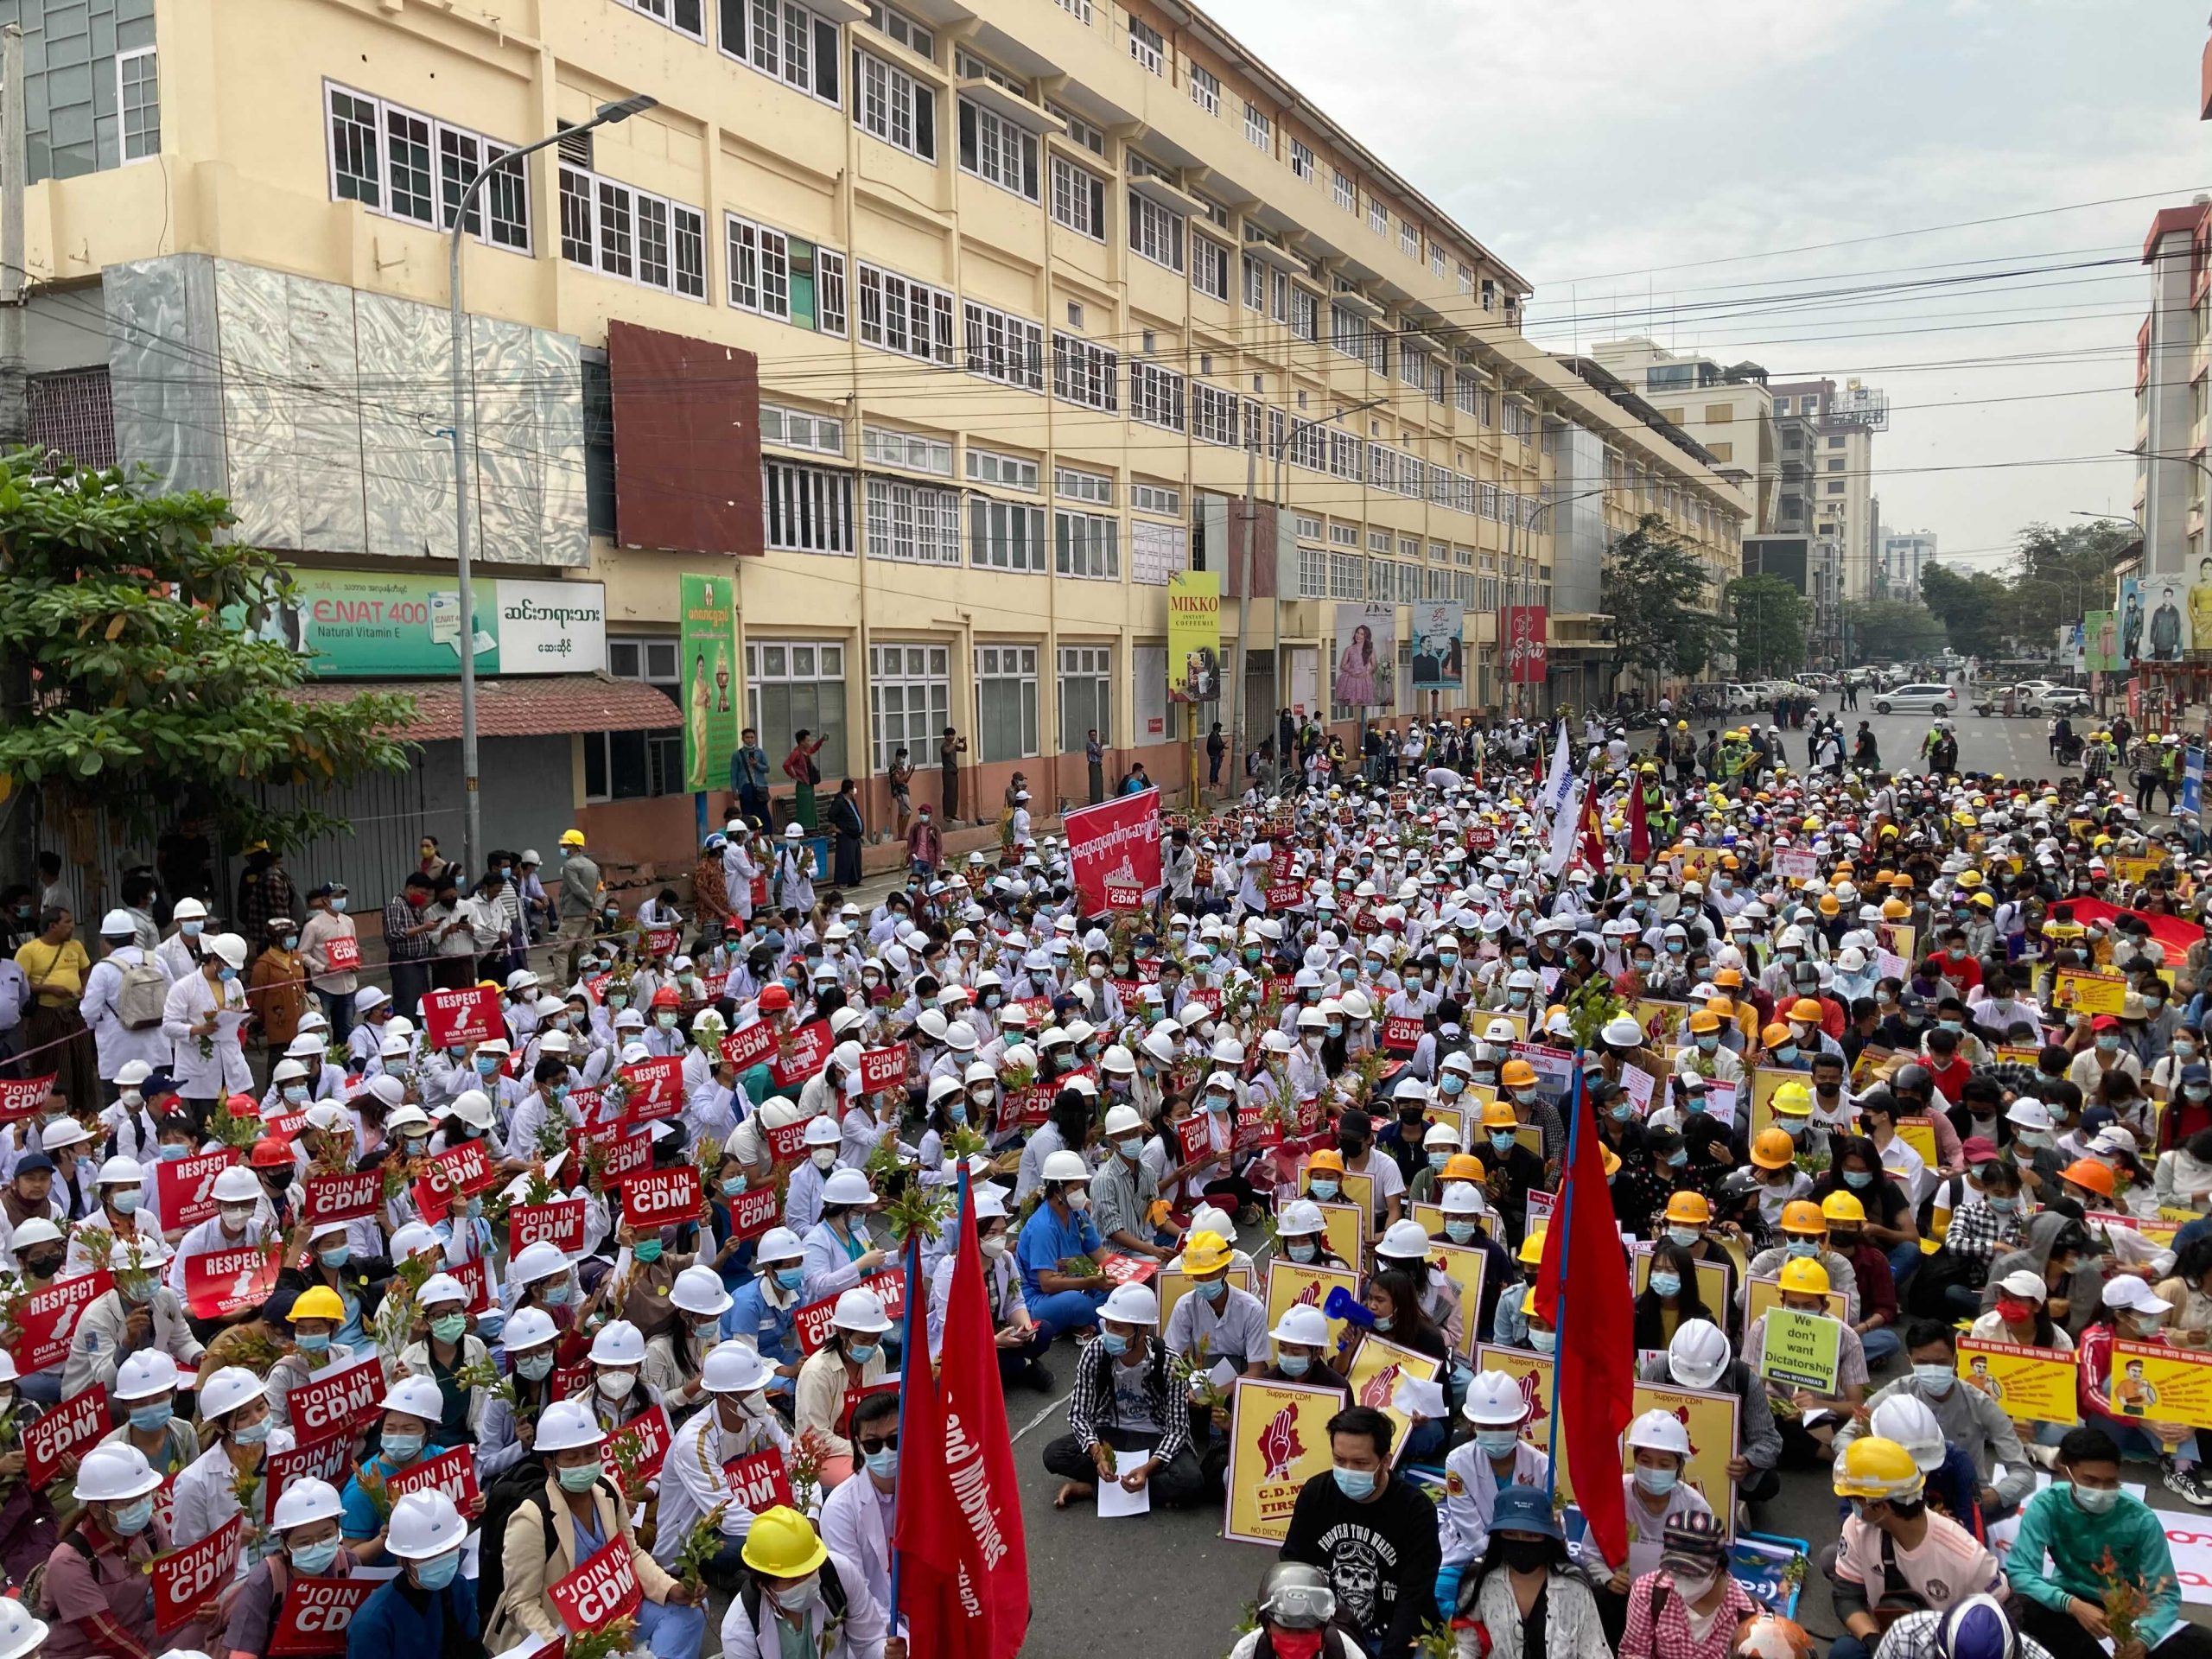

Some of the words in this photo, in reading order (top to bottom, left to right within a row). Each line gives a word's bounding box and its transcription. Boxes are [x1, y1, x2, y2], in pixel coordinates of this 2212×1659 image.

[314, 598, 384, 623] ENAT
[388, 602, 429, 625] 400
[1171, 596, 1218, 612] MIKKO
[318, 626, 353, 638] Natural
[357, 626, 392, 638] Vitamin
[395, 627, 400, 638] E
[1136, 963, 1149, 971] OIN
[436, 991, 481, 1009] RESPECT
[445, 1029, 461, 1039] OUR
[462, 1027, 487, 1036] VOTES
[721, 1034, 752, 1052] “JOIN
[753, 1025, 766, 1040] IN
[862, 1052, 892, 1067] “JOIN
[893, 1050, 903, 1060] IN
[1524, 1045, 1541, 1055] CDM
[634, 1064, 671, 1083] RESPECT
[1, 1084, 38, 1096] “JOIN
[572, 1092, 600, 1106] ESPEC
[653, 1100, 671, 1109] VOTES
[280, 1113, 308, 1133] RESPE
[1237, 1111, 1258, 1123] OIN
[634, 1135, 646, 1150] IN
[463, 1147, 478, 1160] IN
[177, 1154, 228, 1180] RESPECT
[311, 1181, 354, 1198] “JOIN
[359, 1175, 374, 1190] IN
[624, 1177, 667, 1195] “JOIN
[673, 1173, 690, 1188] IN
[180, 1205, 198, 1215] OUR
[734, 1194, 765, 1212] “JOIN
[513, 1211, 554, 1227] “JOIN
[560, 1206, 575, 1219] IN
[463, 1268, 478, 1281] IN
[880, 1274, 896, 1290] IN
[1294, 1269, 1315, 1280] Support
[30, 1279, 95, 1316] RESPECT
[218, 1298, 241, 1308] OUR
[798, 1304, 834, 1328] “JOIN
[1795, 1314, 1812, 1326] We
[33, 1341, 57, 1356] OUR
[1787, 1344, 1815, 1357] want
[2119, 1343, 2137, 1351] WHAT
[2163, 1350, 2179, 1358] POTS
[2180, 1352, 2195, 1361] AND
[1508, 1356, 1535, 1368] Support
[1536, 1360, 1553, 1369] CDM
[1765, 1351, 1834, 1376] Dictatorship
[1772, 1370, 1790, 1379] #Save
[1791, 1374, 1823, 1387] MYANMAR
[291, 1381, 343, 1409] “JOIN
[349, 1369, 370, 1389] IN
[1266, 1389, 1294, 1402] Support
[1295, 1393, 1312, 1402] CDM
[1653, 1392, 1684, 1404] Support
[1685, 1397, 1703, 1406] CDM
[27, 1408, 70, 1446] “JOIN
[76, 1395, 95, 1418] IN
[945, 1414, 980, 1465] and
[273, 1451, 327, 1477] “JOIN
[331, 1433, 346, 1455] IN
[442, 1457, 461, 1479] IN
[750, 1460, 769, 1480] IN
[949, 1454, 1008, 1572] Midwives
[1250, 1526, 1262, 1535] NO
[1262, 1527, 1287, 1538] DICTAT
[158, 1541, 214, 1582] “JOIN
[220, 1525, 237, 1549] IN
[1351, 1523, 1370, 1541] TWO
[1370, 1531, 1397, 1567] WHEELS
[556, 1560, 610, 1604] “JOIN
[610, 1544, 626, 1567] IN
[296, 1583, 360, 1605] “JOIN
[1383, 1588, 1397, 1601] LIV
